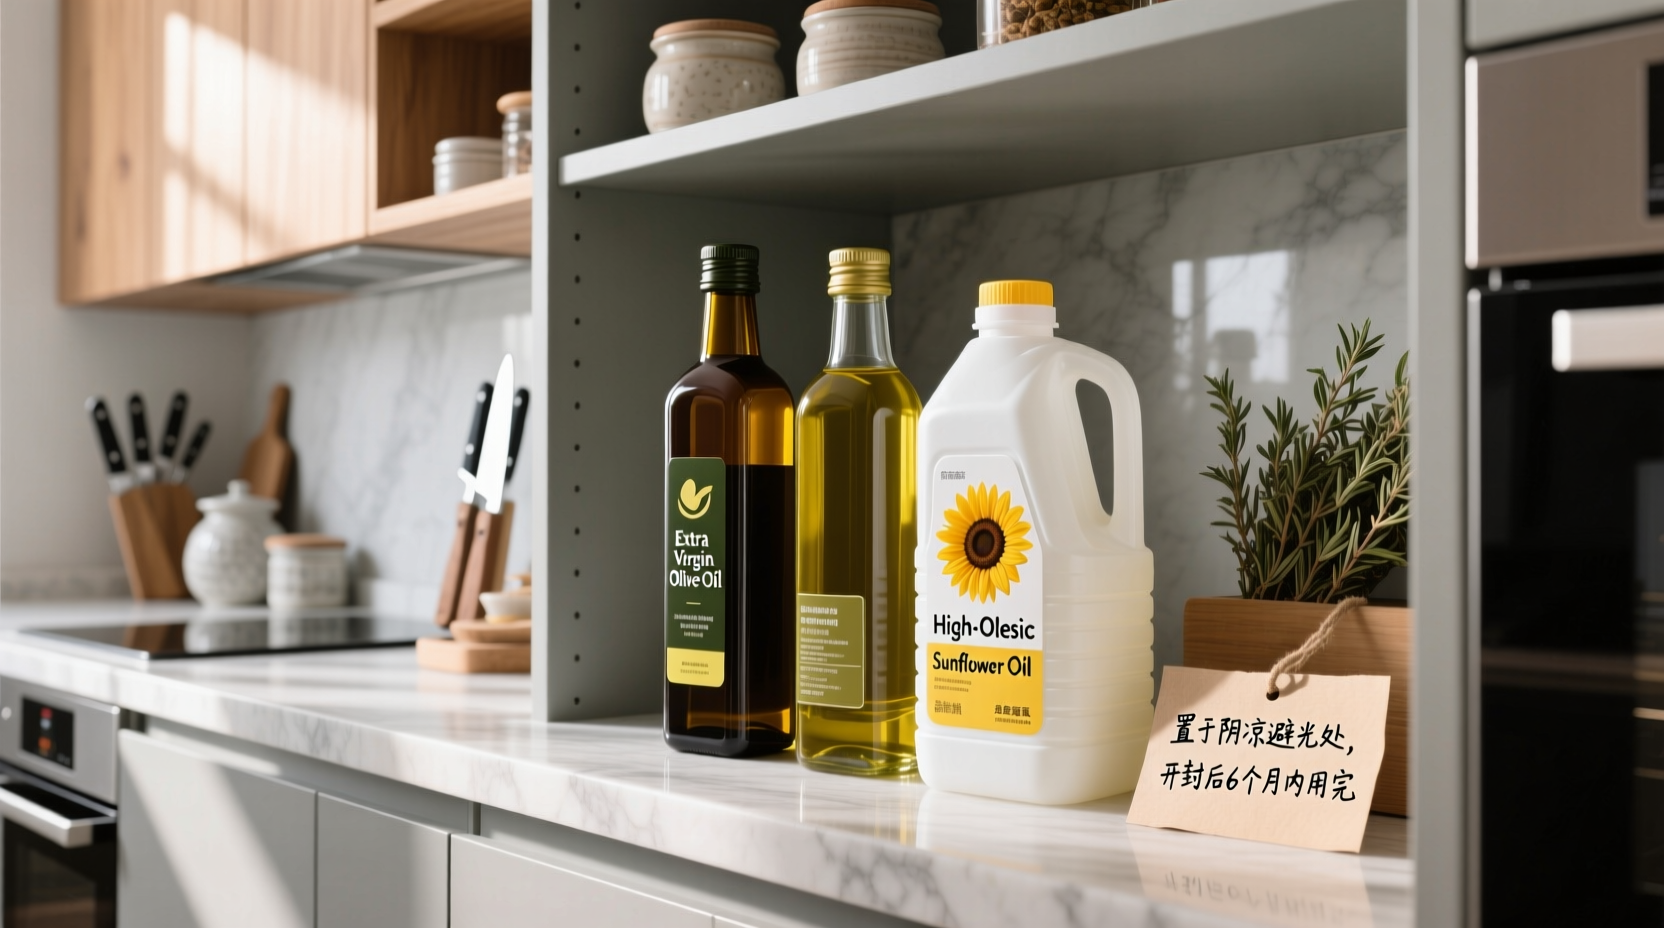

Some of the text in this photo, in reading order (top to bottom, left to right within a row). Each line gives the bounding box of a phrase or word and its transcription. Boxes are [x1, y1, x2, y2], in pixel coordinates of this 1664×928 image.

[675, 530, 709, 547] Extra
[674, 550, 715, 571] Virgin
[669, 569, 722, 588] Olive Oil
[933, 614, 1035, 641] High-Olesic
[932, 651, 1031, 677] Sunflower Oil
[1160, 759, 1356, 801] 开封后6个月内用完
